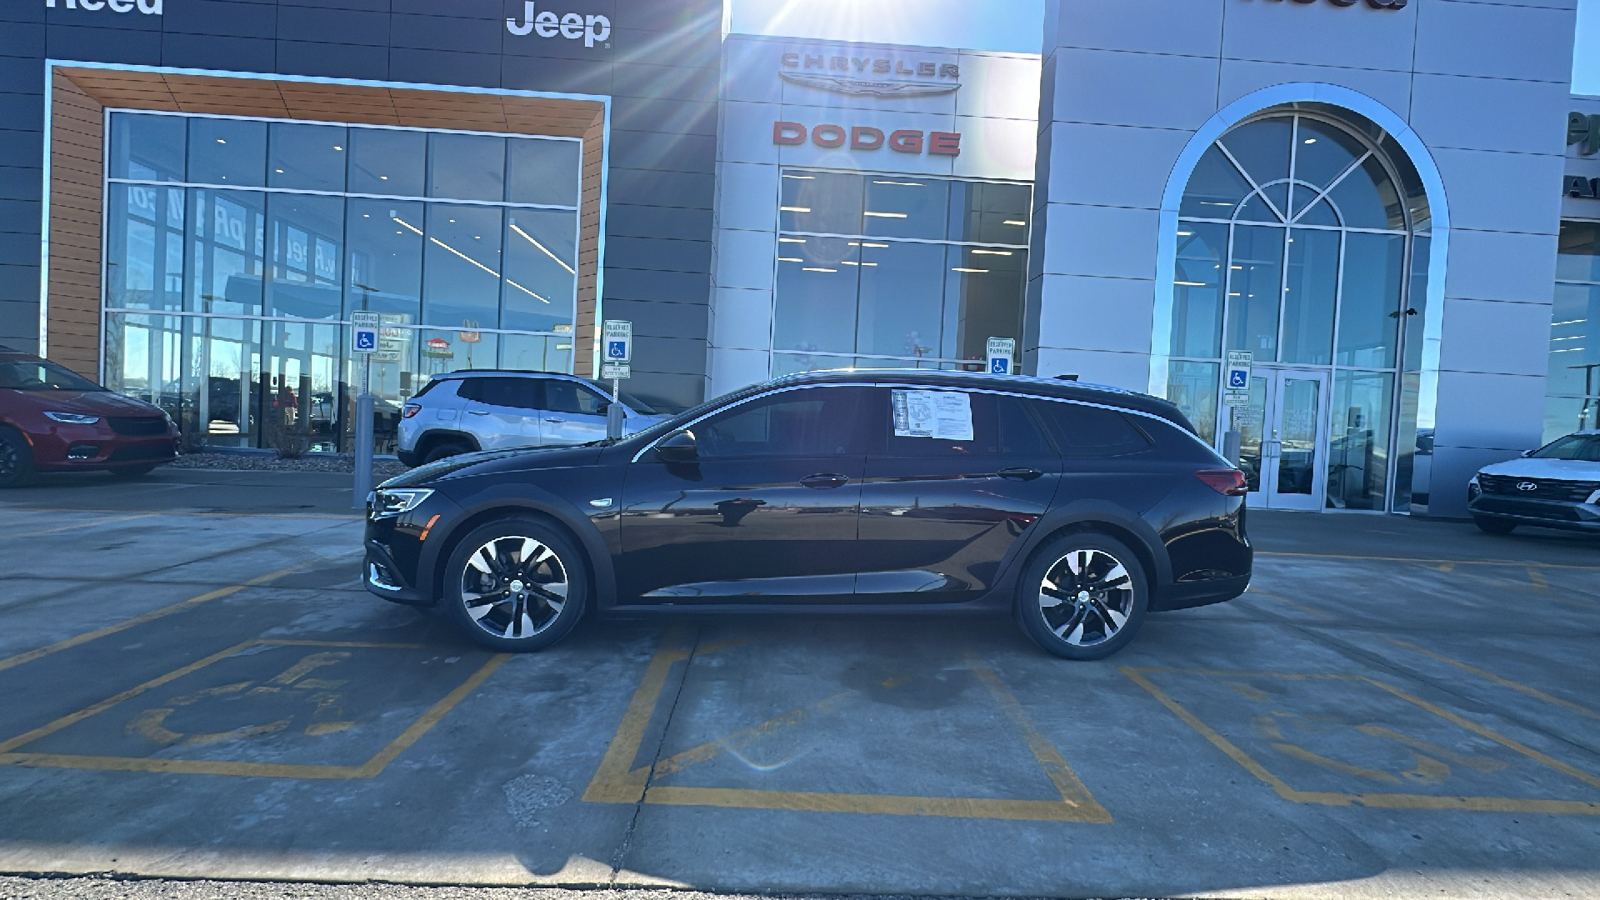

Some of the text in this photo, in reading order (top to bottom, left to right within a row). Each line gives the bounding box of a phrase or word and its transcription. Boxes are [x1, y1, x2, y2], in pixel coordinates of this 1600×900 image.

[506, 1, 611, 48] Jeep
[781, 53, 960, 77] CHRYSLER
[773, 121, 961, 156] DODGE
